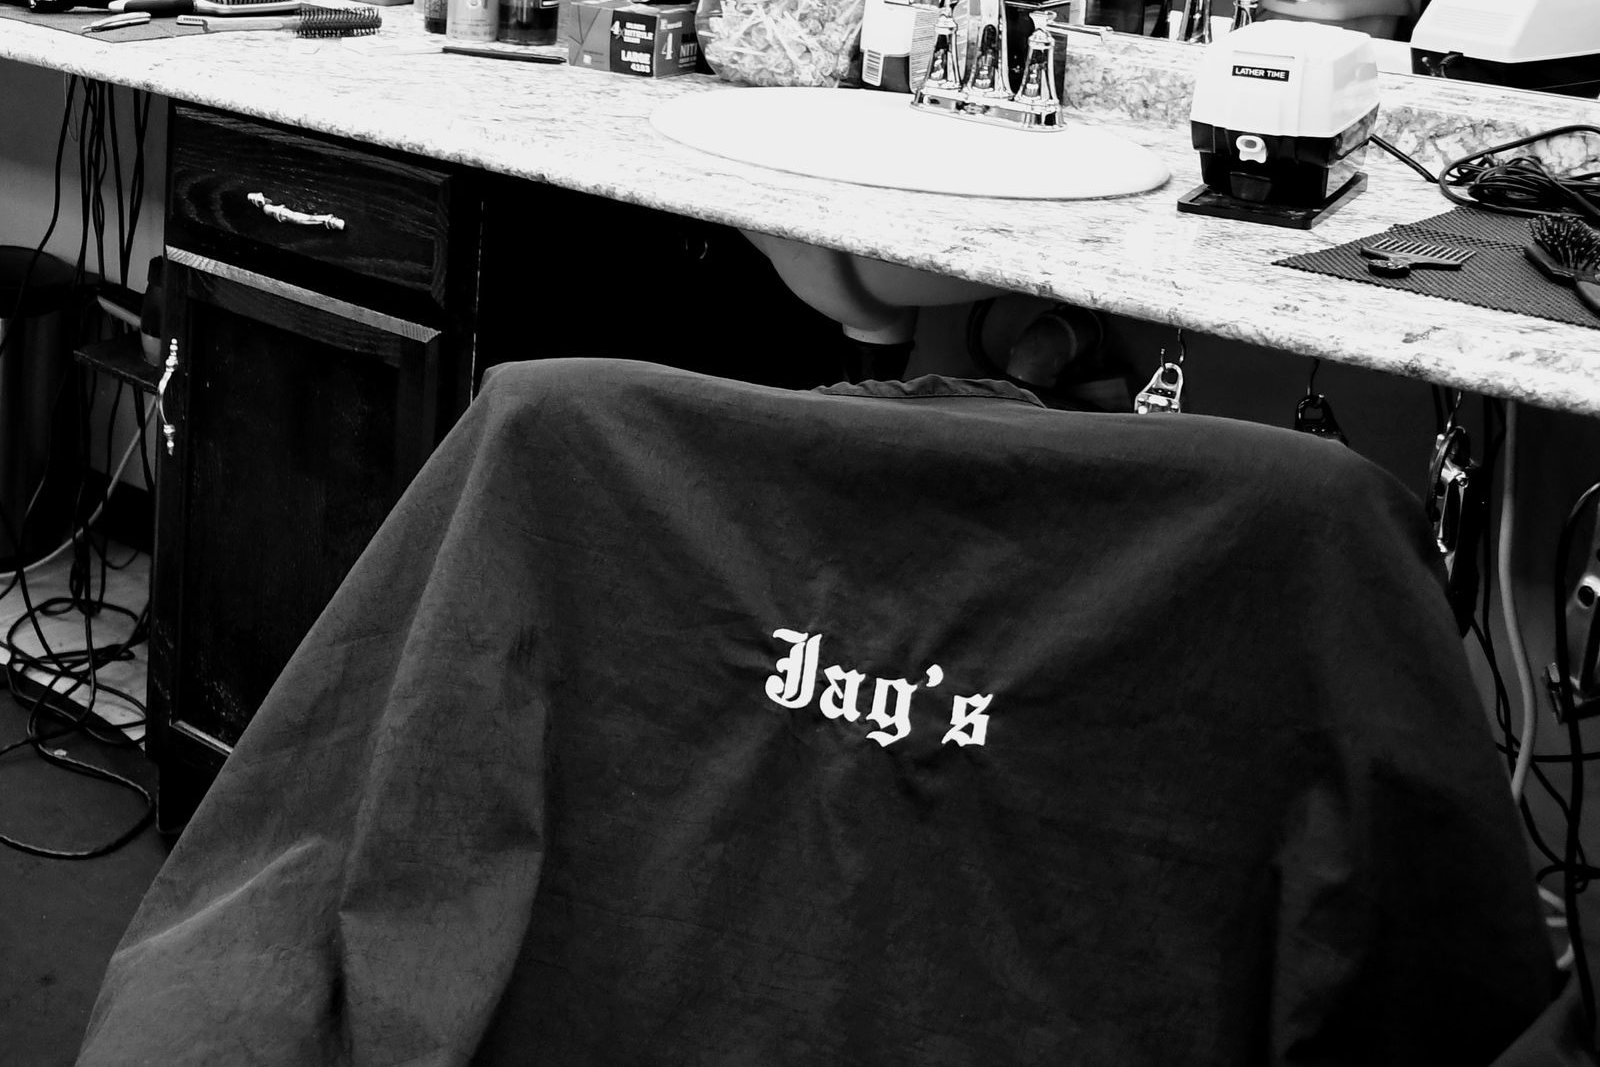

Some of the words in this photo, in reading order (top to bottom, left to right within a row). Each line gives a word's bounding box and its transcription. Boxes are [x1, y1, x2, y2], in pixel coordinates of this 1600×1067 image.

[621, 49, 651, 65] LARGE
[1235, 67, 1265, 77] LATHER
[1266, 70, 1286, 79] TIME
[765, 628, 993, 747] Jag's
